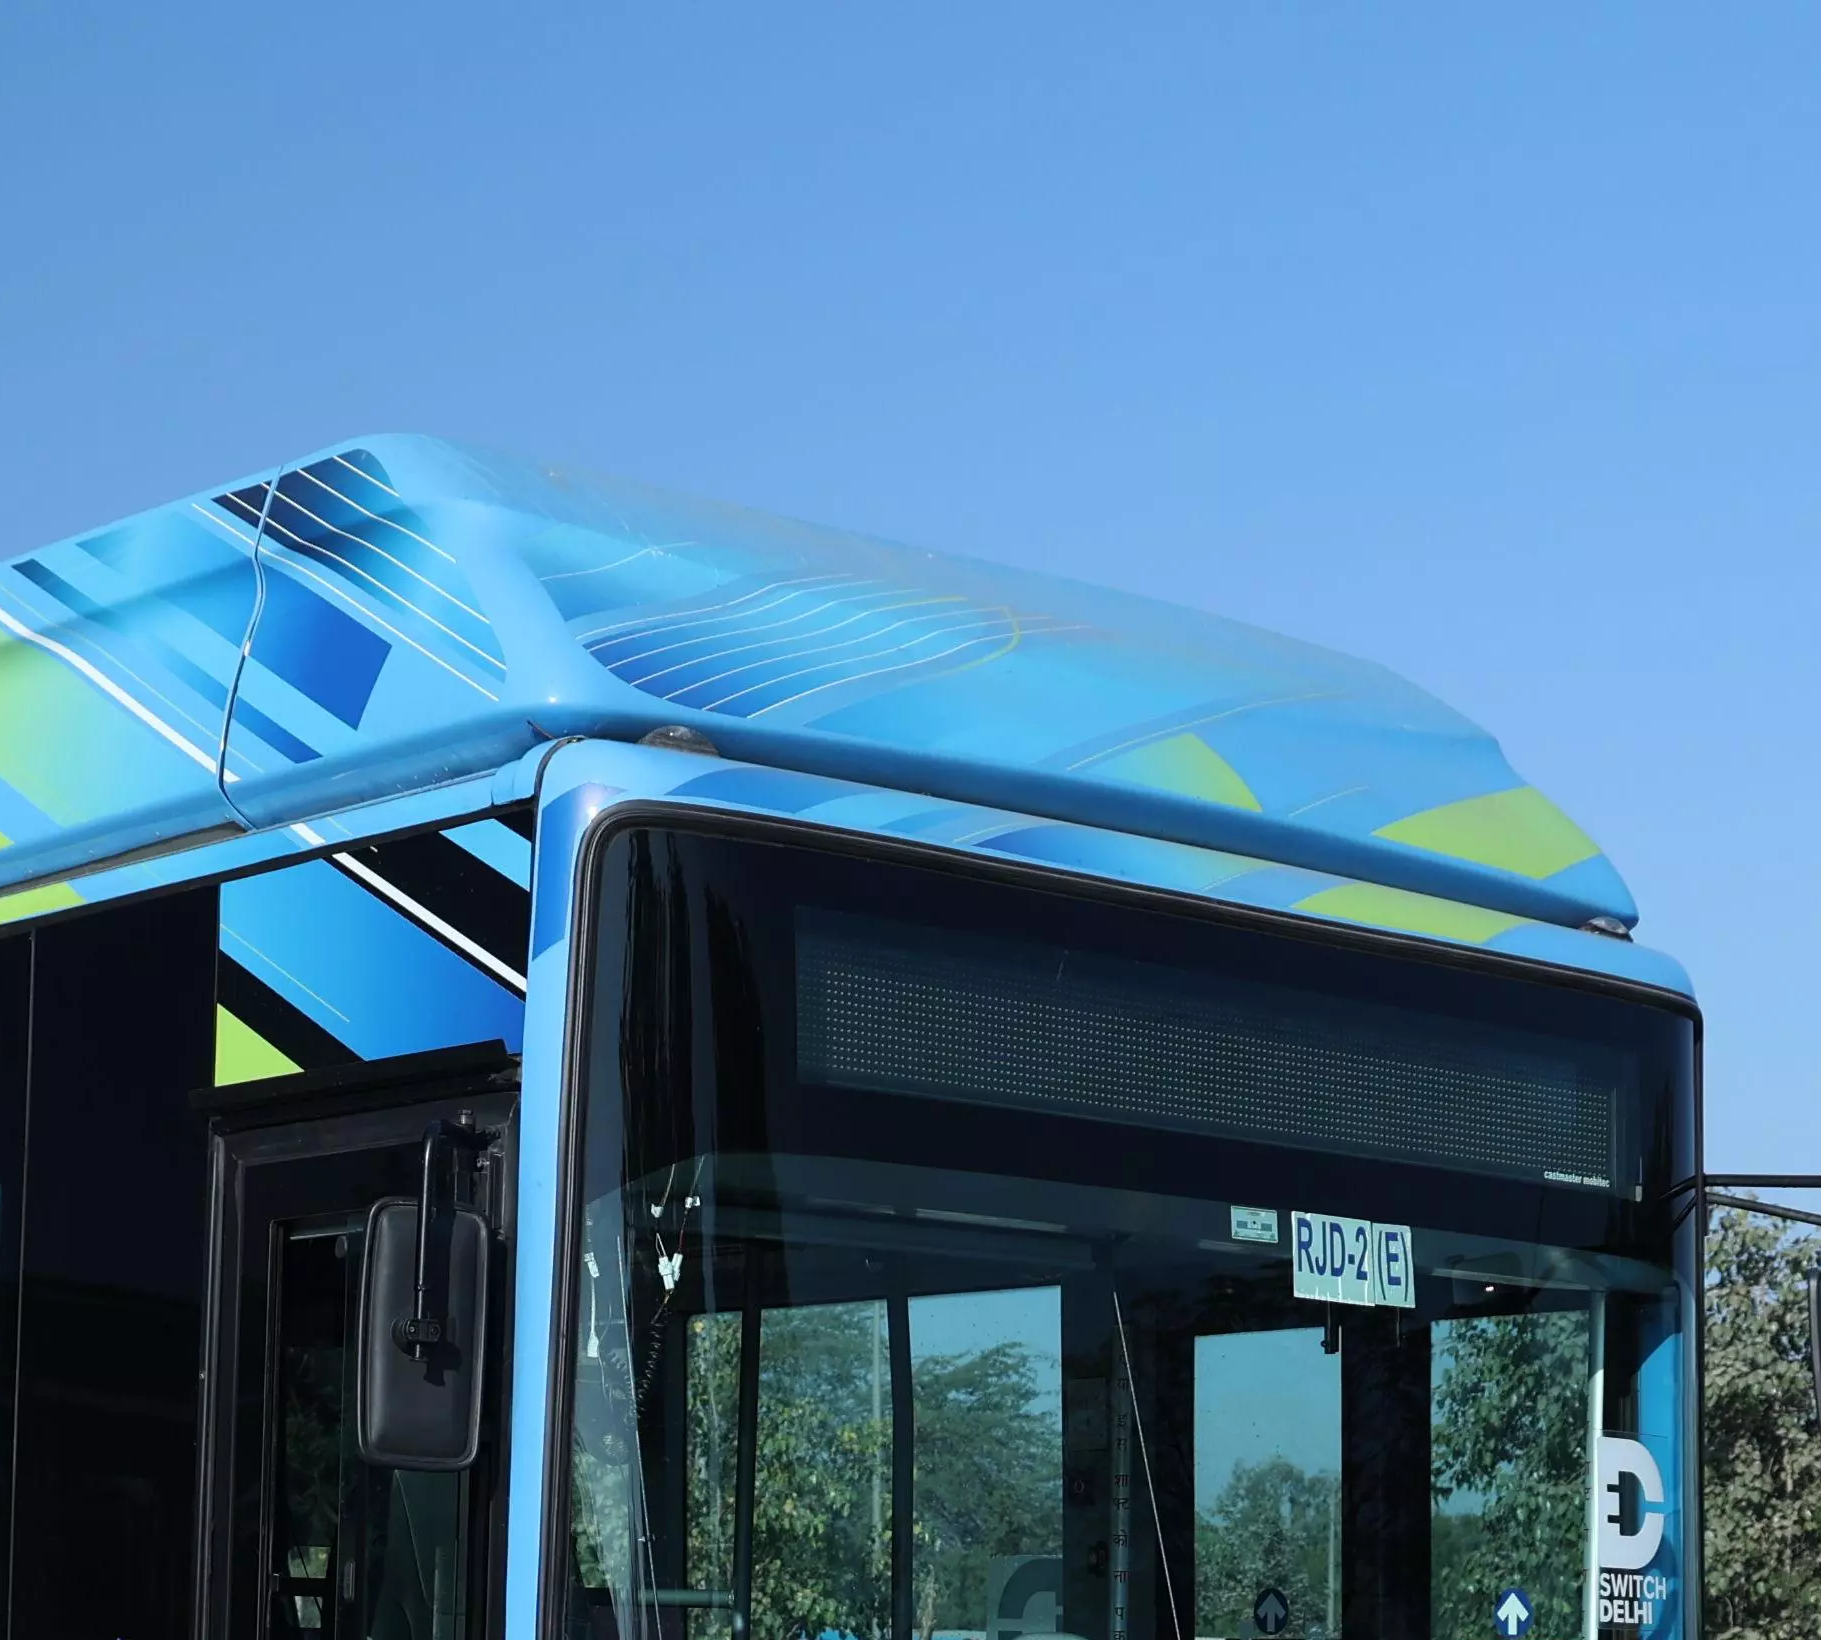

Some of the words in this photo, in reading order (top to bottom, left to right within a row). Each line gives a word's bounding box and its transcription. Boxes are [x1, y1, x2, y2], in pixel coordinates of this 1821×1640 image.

[1297, 1217, 1369, 1281] RJD-2
[1378, 1230, 1409, 1302] (E)
[1599, 1573, 1667, 1599] SWITCH
[1599, 1599, 1653, 1624] DELHI
